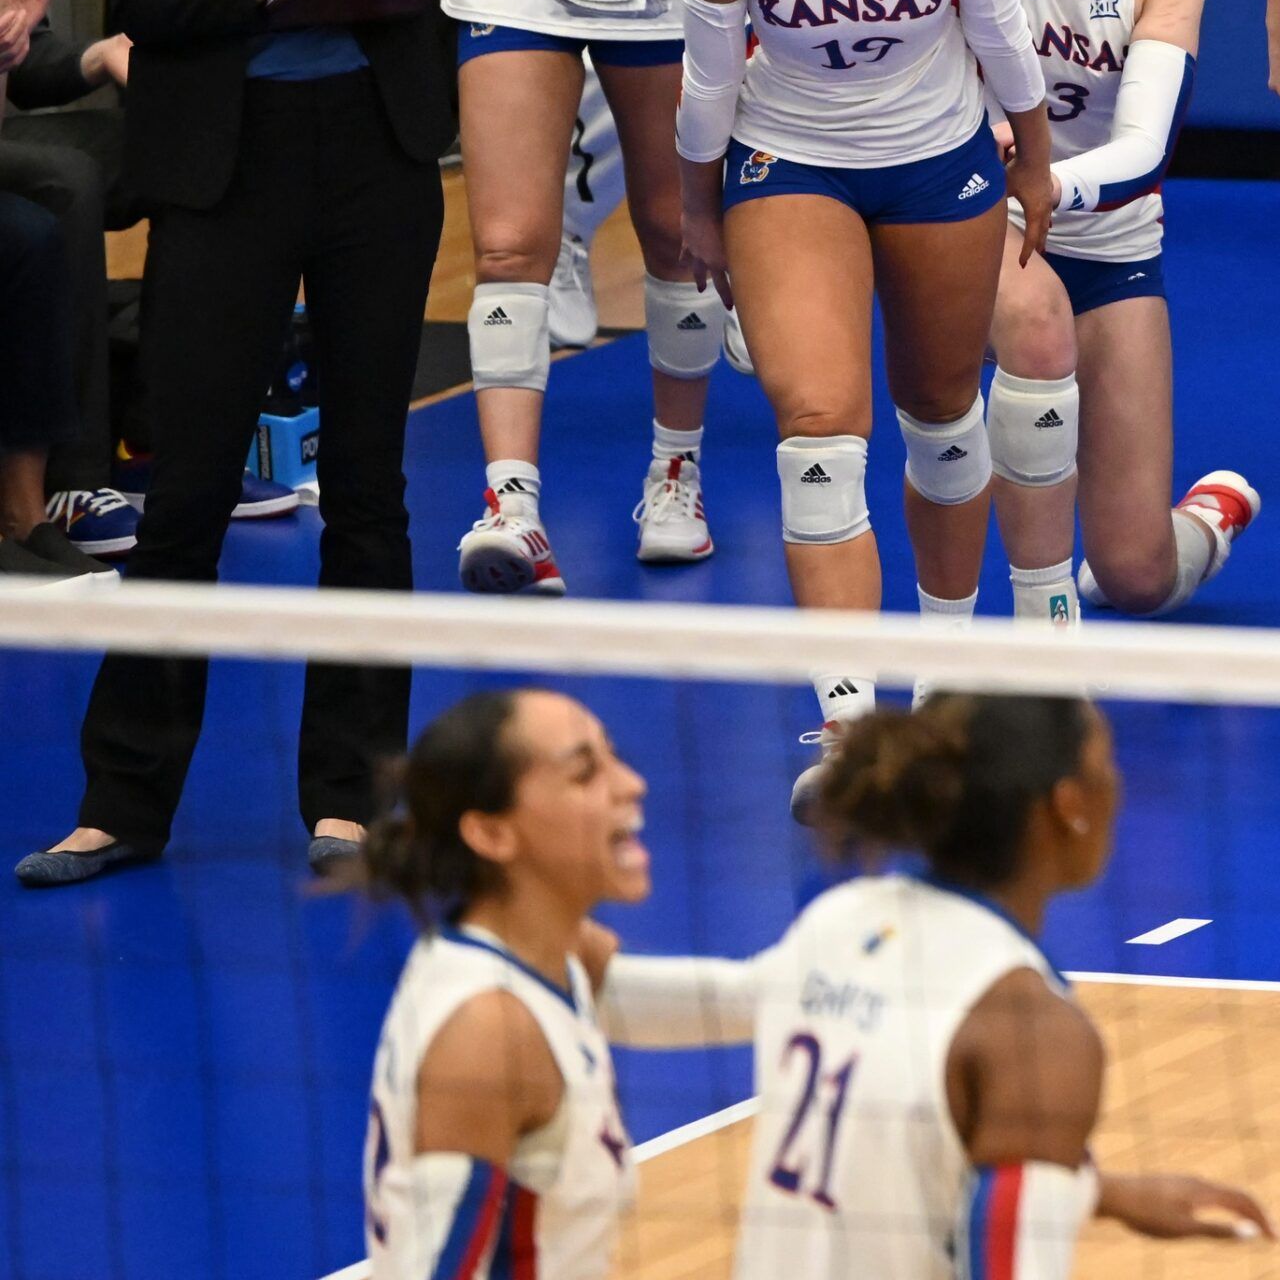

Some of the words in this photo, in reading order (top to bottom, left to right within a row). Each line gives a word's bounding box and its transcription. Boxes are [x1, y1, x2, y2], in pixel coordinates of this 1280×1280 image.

[1034, 21, 1130, 73] NSA
[1047, 82, 1090, 122] 3
[957, 180, 990, 200] adidas
[1034, 419, 1064, 428] adidas
[800, 475, 832, 483] adidas
[768, 1030, 862, 1214] 21
